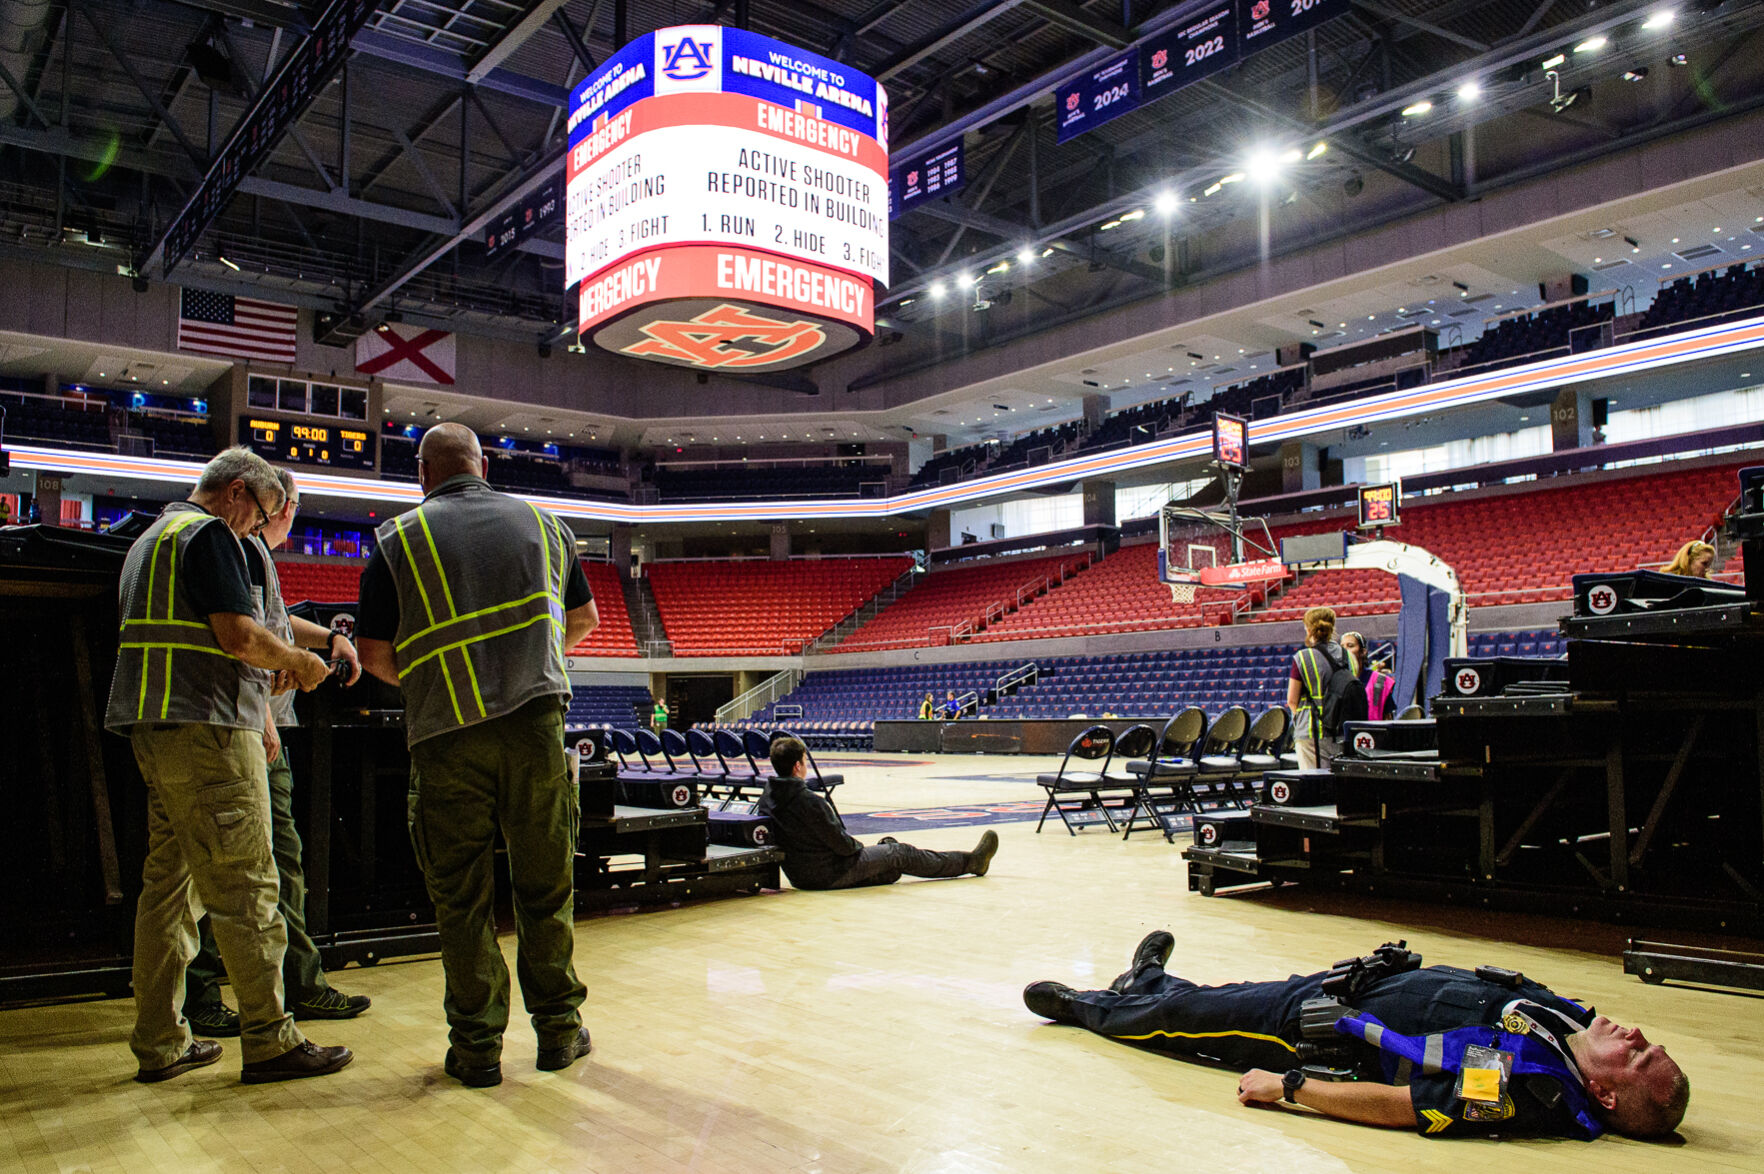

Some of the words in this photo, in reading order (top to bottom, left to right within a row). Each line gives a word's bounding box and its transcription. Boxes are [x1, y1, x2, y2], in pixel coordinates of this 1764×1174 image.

[1185, 36, 1224, 67] 2022
[604, 62, 646, 103] ARENA
[769, 51, 829, 82] WELCOME
[829, 72, 846, 87] TO
[732, 55, 813, 95] NEVILLE
[815, 82, 873, 118] ARENA
[1094, 83, 1129, 111] 2024
[574, 109, 633, 172] EMERGENCY
[757, 102, 860, 157] EMERGENCY
[738, 148, 797, 182] ACTIVE
[804, 165, 870, 204] SHOOTER
[609, 174, 665, 216] BUILDING
[708, 172, 798, 208] REPORTED
[805, 192, 820, 214] IN
[631, 215, 669, 242] FIGHT
[702, 213, 712, 232] 1.
[721, 214, 755, 237] RUN
[774, 224, 788, 245] 2.
[794, 229, 825, 254] HIDE
[843, 242, 856, 262] 3.
[717, 253, 865, 318] EMERGENCY
[1554, 407, 1575, 421] 102
[250, 419, 280, 431] AUBURN
[293, 425, 328, 442] 99:00
[340, 430, 367, 441] TIGERS
[265, 430, 275, 442] 0
[354, 440, 362, 452] 0
[1283, 456, 1300, 468] 103
[39, 479, 60, 490] 108
[1368, 502, 1389, 520] 25
[1215, 630, 1221, 642] B
[567, 659, 574, 669] D
[914, 651, 920, 660] C
